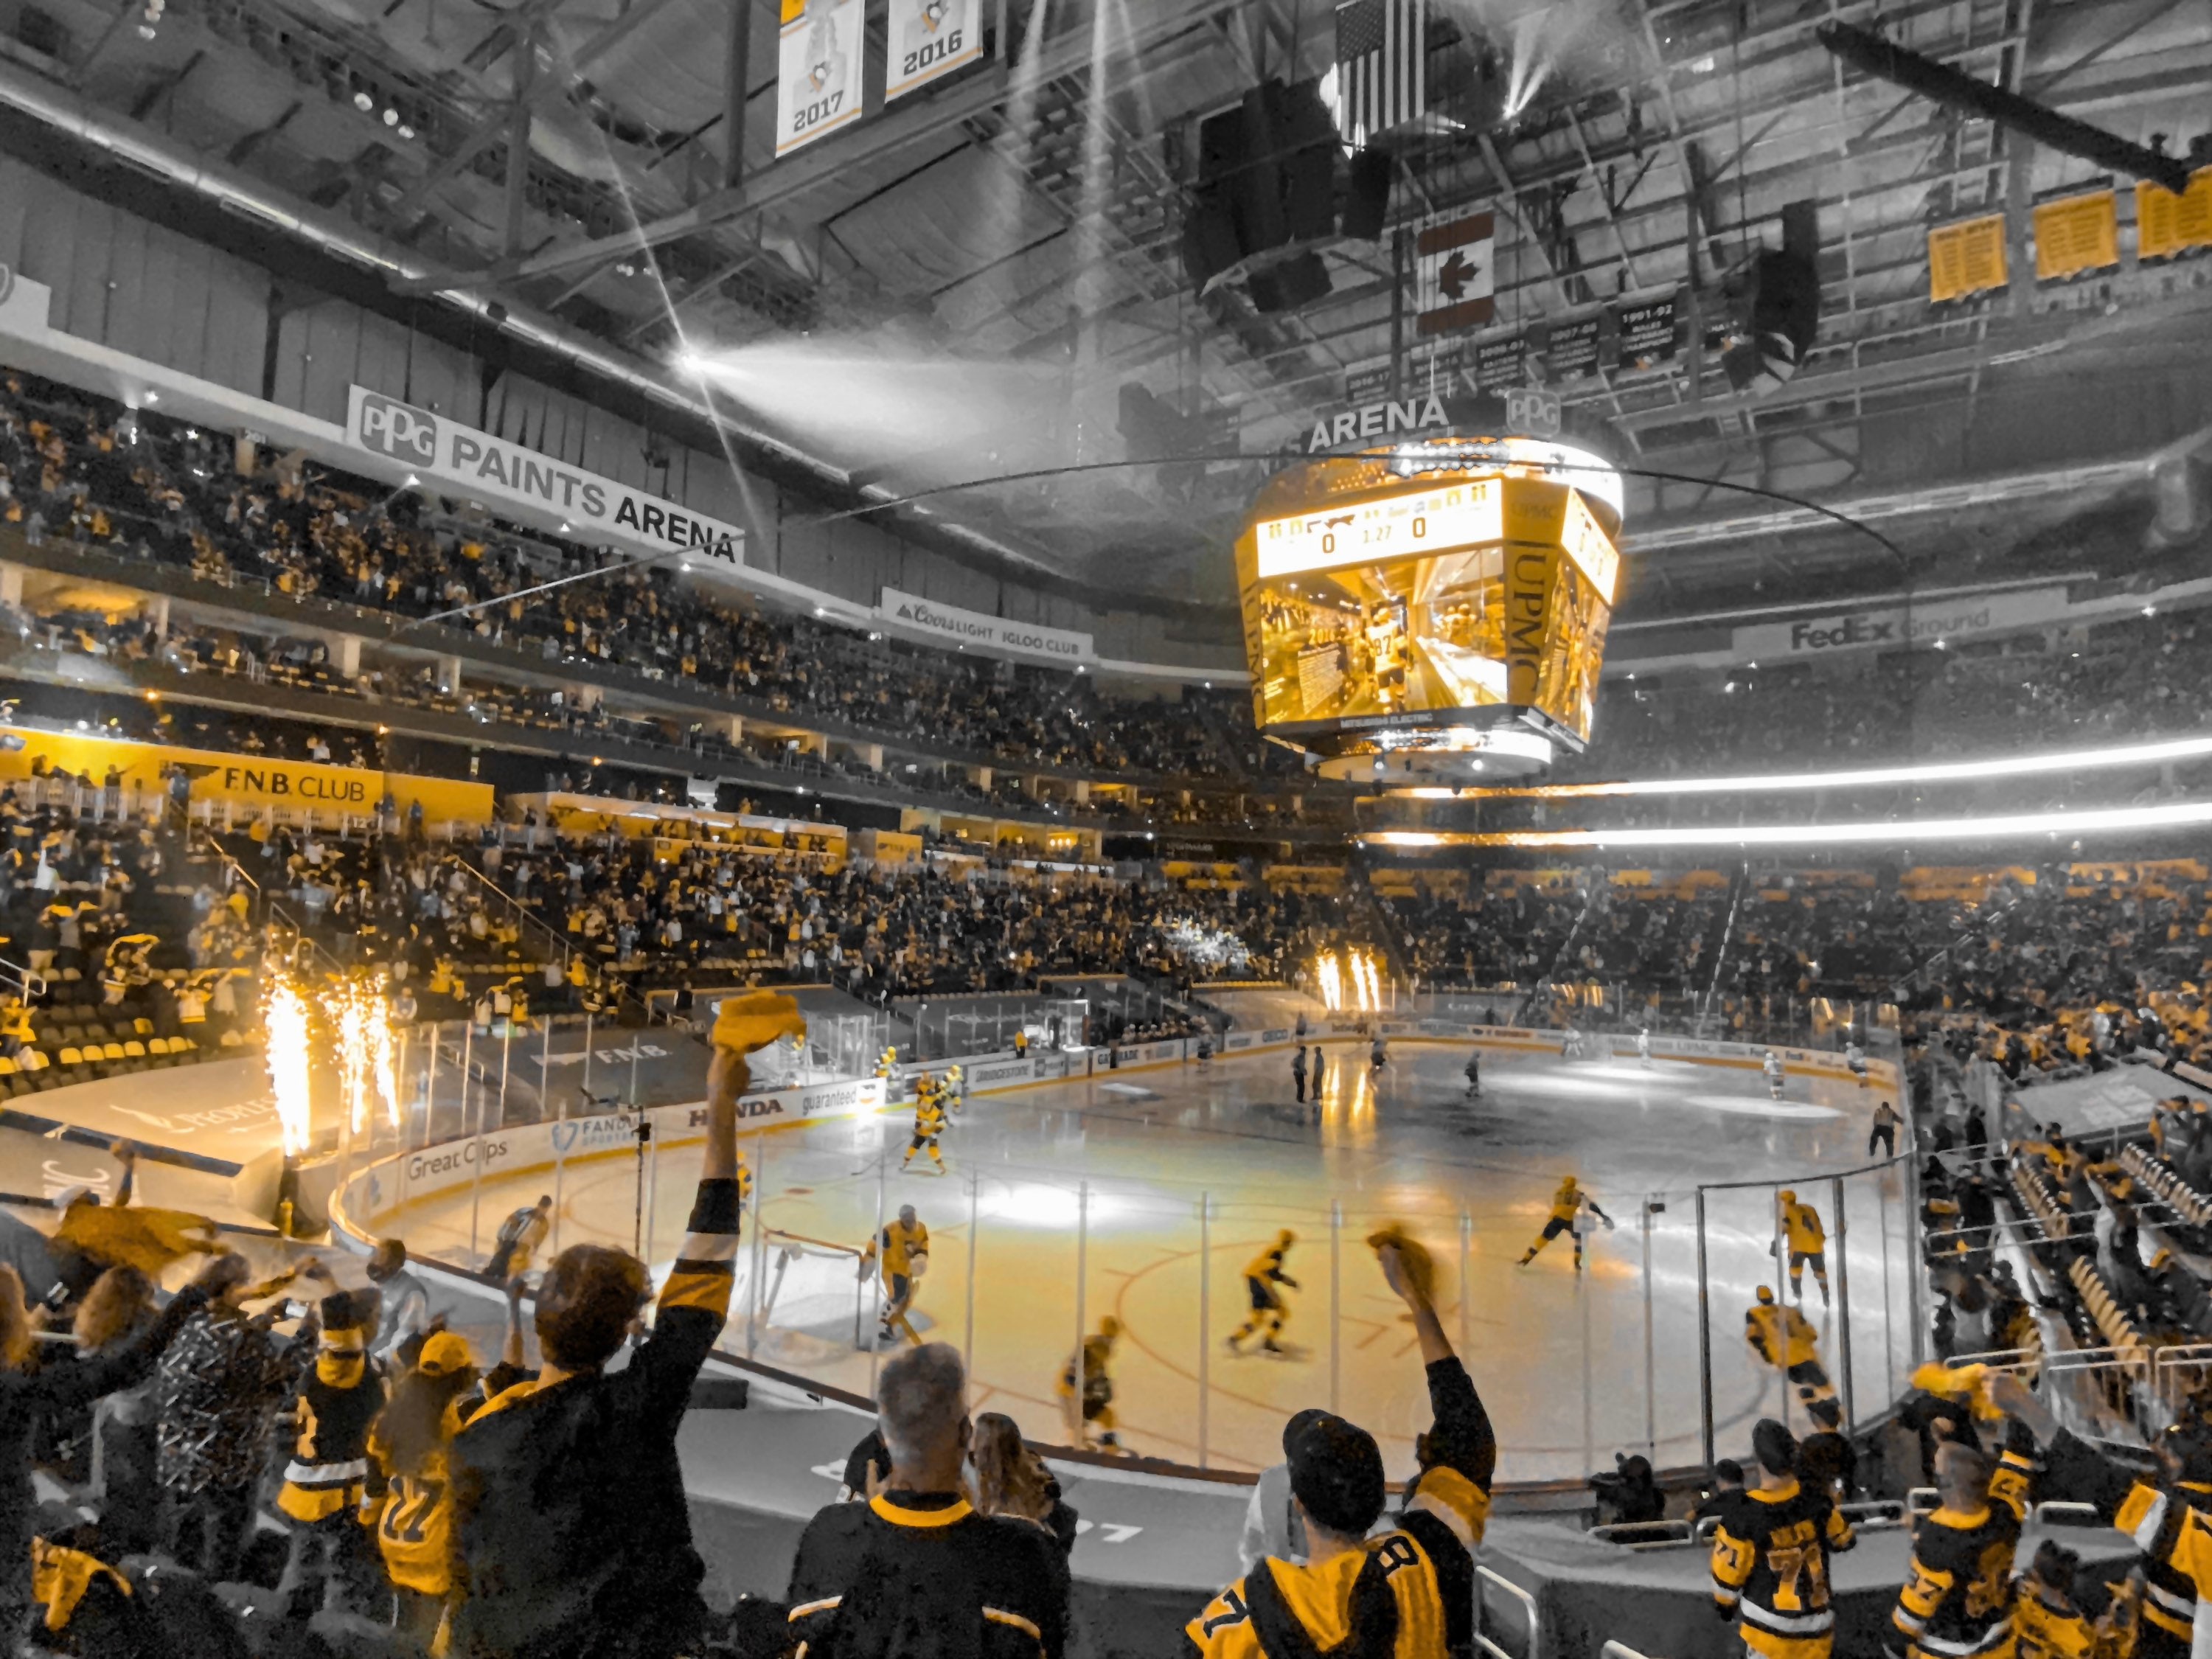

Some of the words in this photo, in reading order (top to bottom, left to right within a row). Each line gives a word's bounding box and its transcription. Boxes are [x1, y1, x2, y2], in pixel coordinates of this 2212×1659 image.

[903, 29, 963, 76] 2016
[793, 90, 844, 133] 2017
[1308, 395, 1450, 454] ARENA
[1511, 395, 1557, 428] PPG
[363, 404, 434, 456] PPG
[451, 434, 607, 518] PAINTS
[614, 496, 737, 564] ARENA
[1322, 533, 1335, 554] 0
[1412, 517, 1427, 538] 0
[956, 621, 994, 640] LIGHT
[1001, 631, 1043, 650] IGLOO
[1046, 639, 1079, 655] CLUB
[1509, 553, 1548, 693] UPMC
[1791, 616, 1893, 650] FedEx
[298, 776, 366, 802] CLUB
[689, 1099, 784, 1127] HNDA
[802, 1088, 857, 1116] guaranteed
[408, 1151, 462, 1181] Great
[463, 1141, 508, 1167] Cips
[1765, 1545, 1829, 1611] 71
